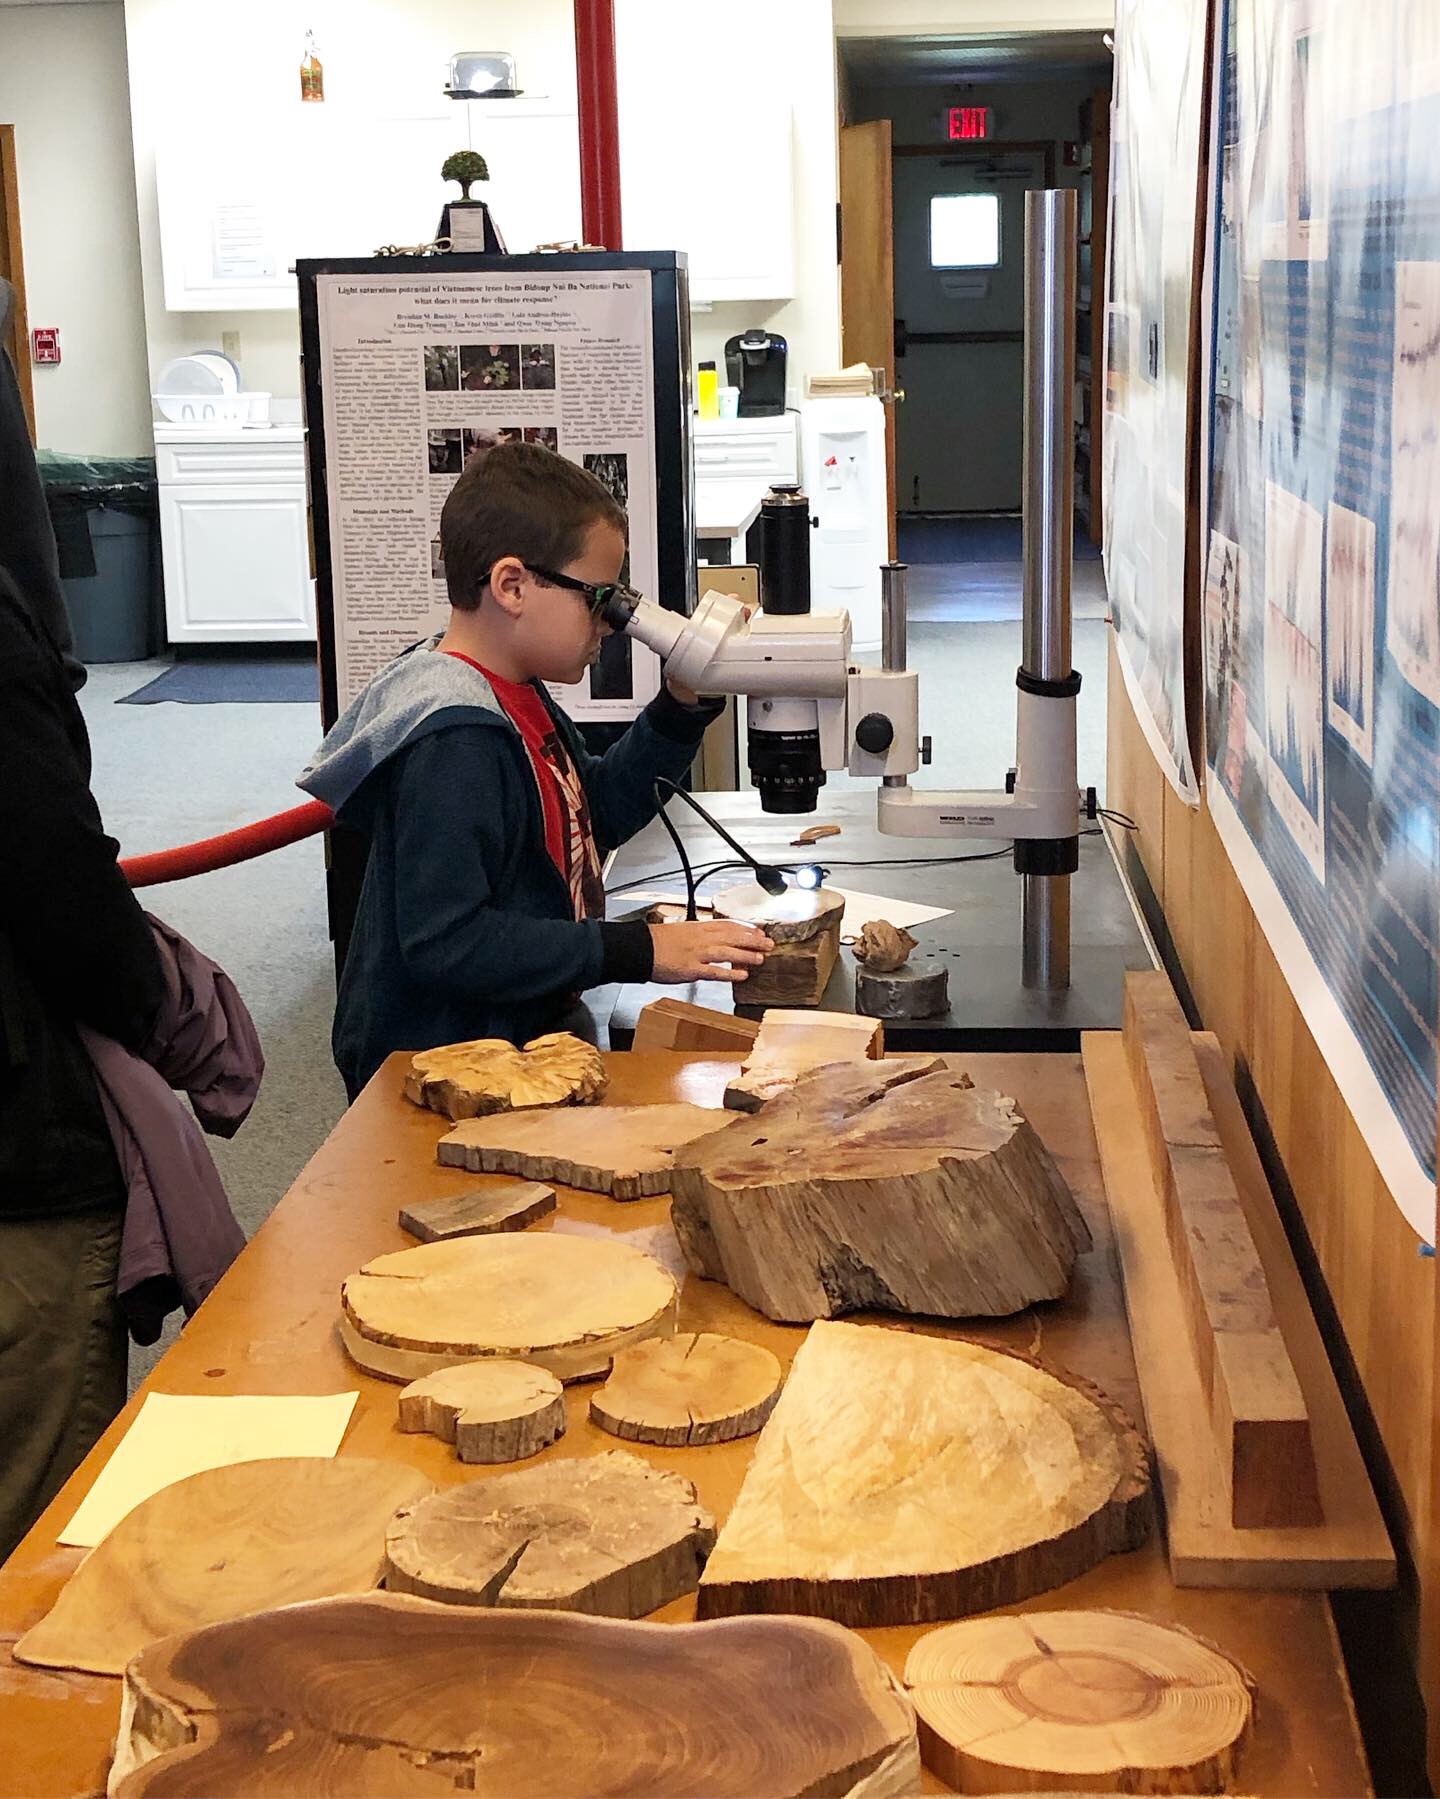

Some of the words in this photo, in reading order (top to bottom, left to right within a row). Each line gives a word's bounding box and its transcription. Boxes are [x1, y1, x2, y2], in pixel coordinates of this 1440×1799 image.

[949, 107, 986, 139] EXIT
[338, 287, 358, 295] Light
[504, 284, 522, 292] from
[414, 297, 432, 305] what
[494, 296, 520, 304] climate
